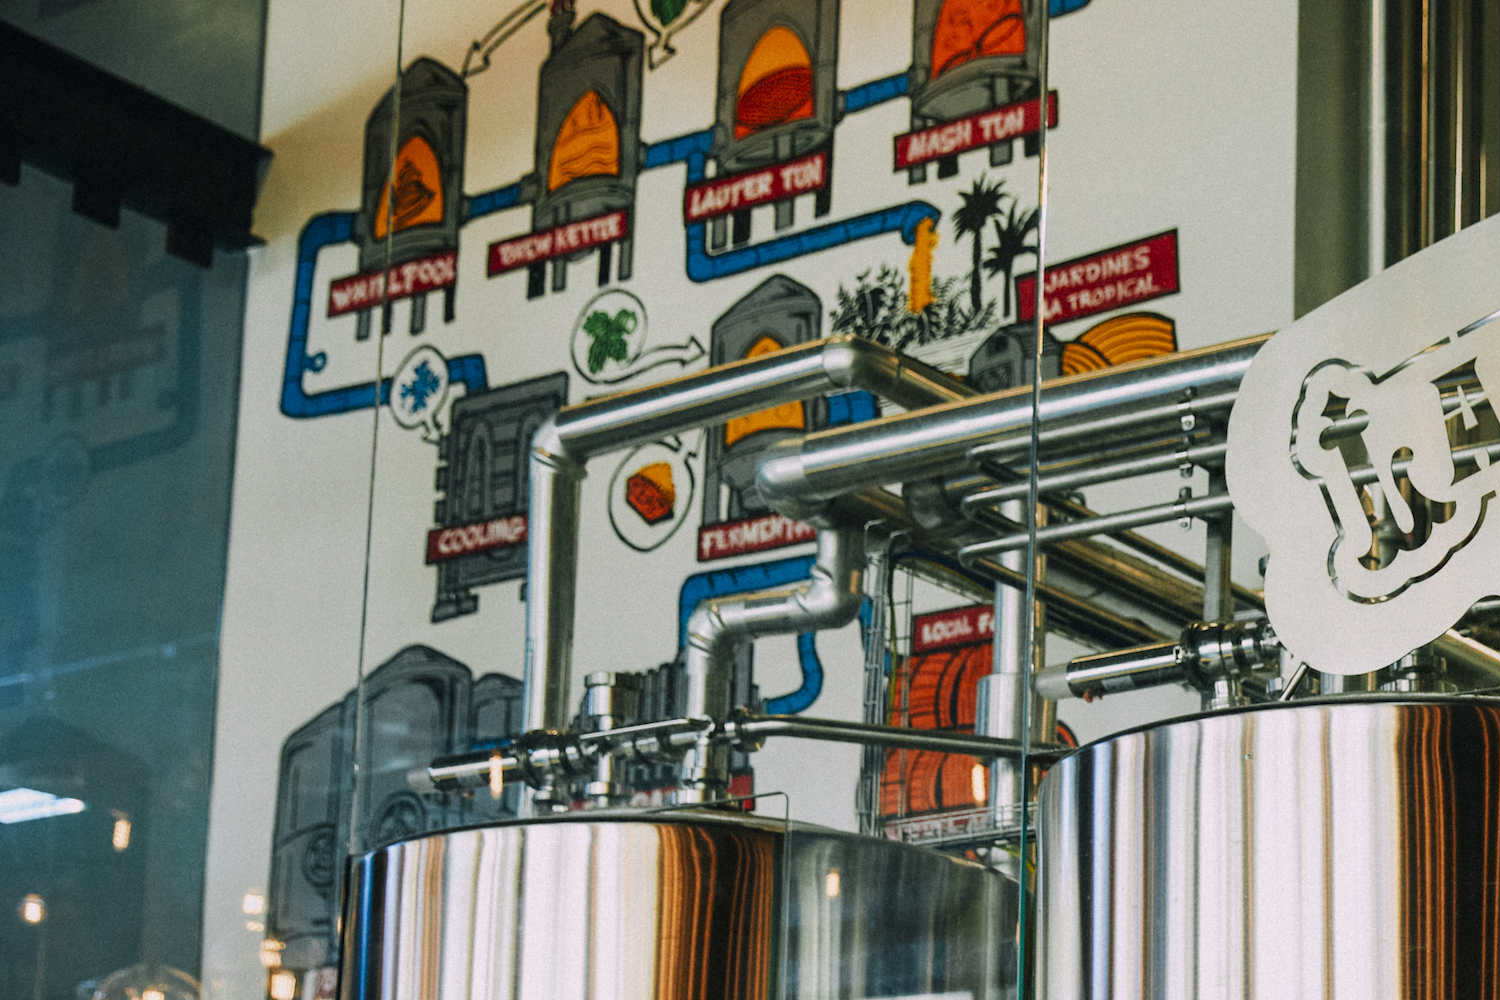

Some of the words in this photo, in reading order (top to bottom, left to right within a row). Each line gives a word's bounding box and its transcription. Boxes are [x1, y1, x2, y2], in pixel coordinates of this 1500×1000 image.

[978, 106, 1025, 142] TUN
[690, 170, 774, 218] LAUTER
[779, 154, 823, 191] TUN
[1044, 245, 1151, 294] JARDINES
[1066, 272, 1161, 311] TROPICAL
[438, 515, 526, 554] COOLING
[921, 615, 973, 644] LOCAL
